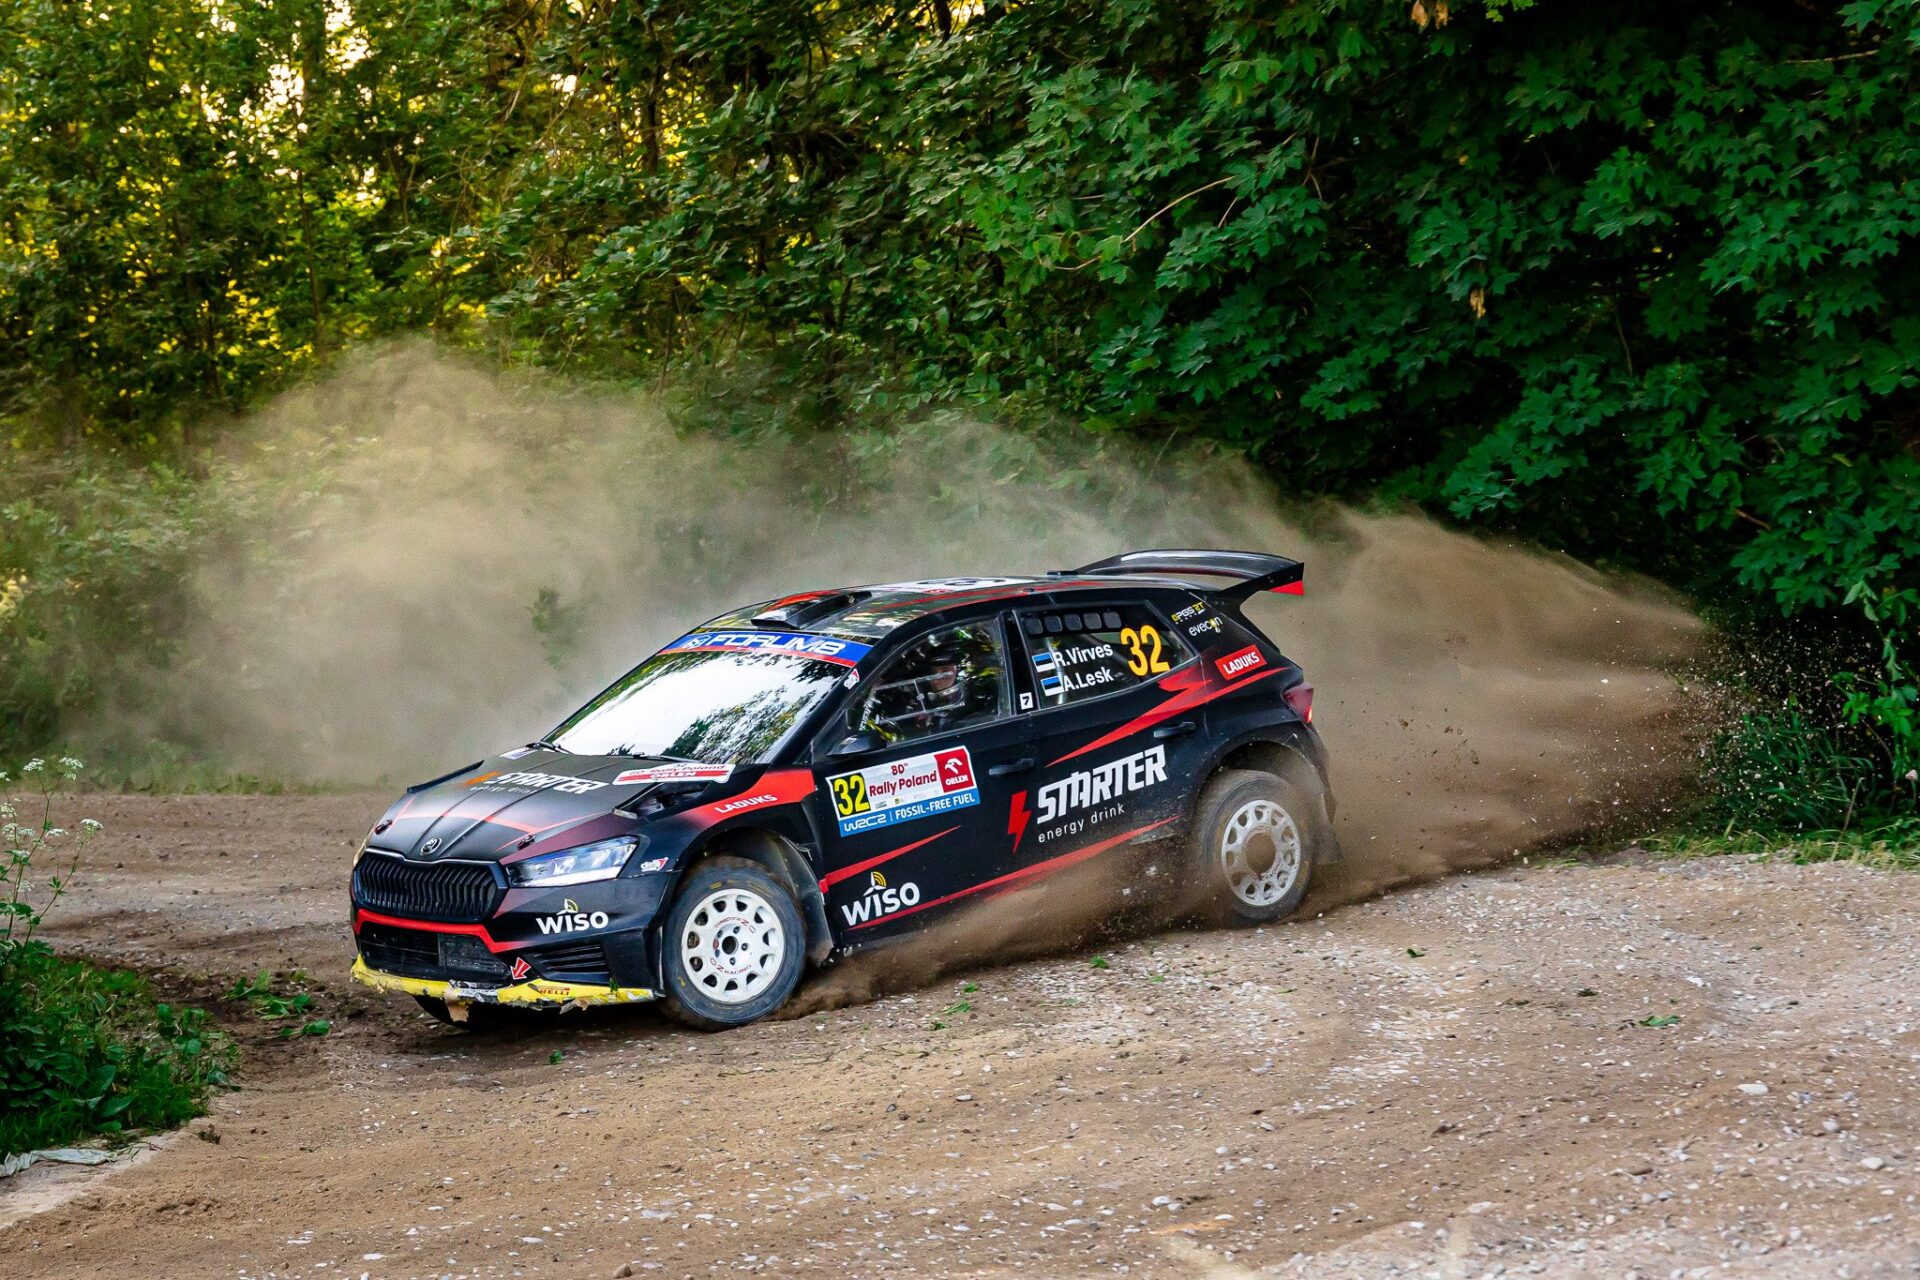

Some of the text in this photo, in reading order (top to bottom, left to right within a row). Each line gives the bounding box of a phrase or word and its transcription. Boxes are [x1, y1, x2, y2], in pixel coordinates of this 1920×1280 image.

[705, 634, 847, 655] FORUM8
[1053, 643, 1114, 668] R.Virves
[1120, 624, 1171, 677] 32
[1222, 651, 1260, 675] LADUKS
[1063, 666, 1115, 692] A.Lesk
[1022, 693, 1032, 706] 7
[483, 772, 610, 795] STARTER
[869, 770, 938, 797] Rally Poland
[945, 774, 969, 786] ORLEN
[1036, 743, 1168, 825] STARTER
[714, 794, 778, 814] LADUKS
[833, 774, 871, 816] 32
[895, 797, 952, 820] FOSSIL-FREE
[952, 793, 976, 807] FUEL
[844, 813, 887, 832] WRC2
[1038, 803, 1125, 843] energy drink
[841, 881, 921, 927] WISO
[536, 908, 609, 935] WISO
